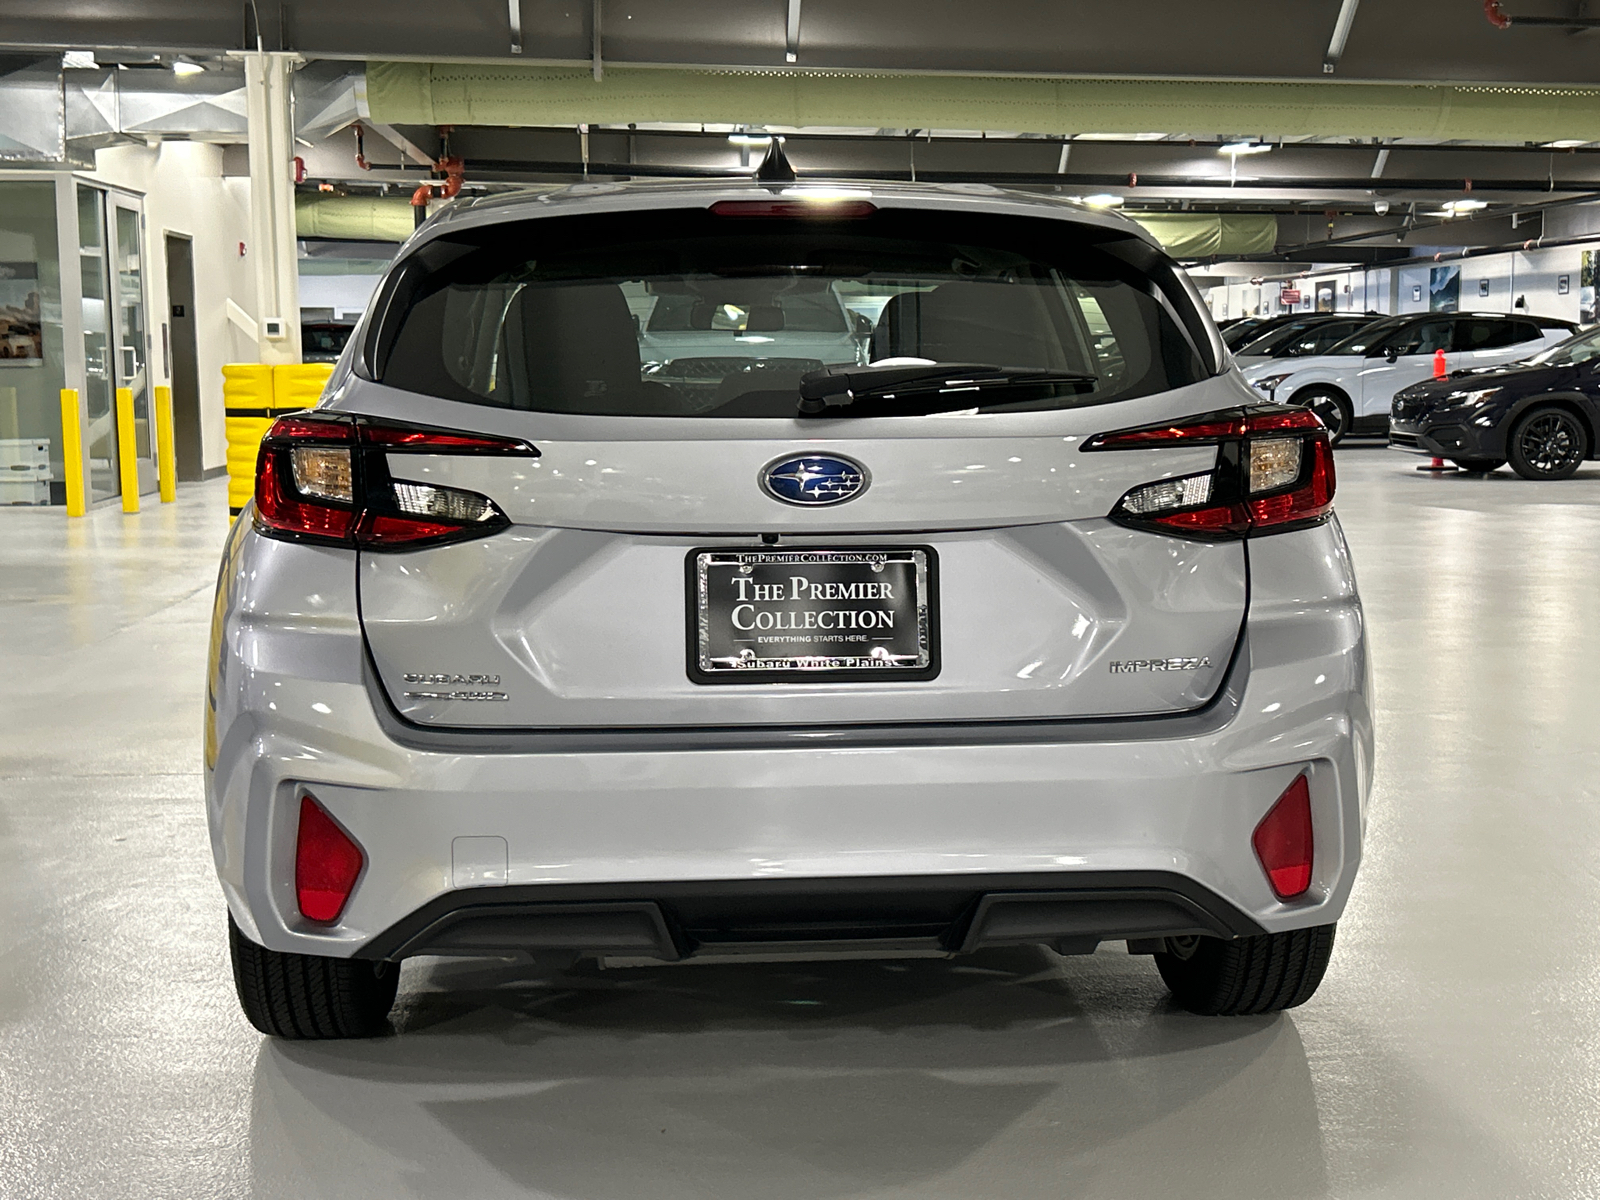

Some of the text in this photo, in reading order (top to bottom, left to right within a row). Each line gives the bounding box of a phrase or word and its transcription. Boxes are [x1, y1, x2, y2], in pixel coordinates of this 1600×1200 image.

[731, 576, 895, 601] THE PREMIER
[731, 604, 895, 630] COLLECTION
[757, 635, 811, 643] EVERYTHING
[738, 660, 791, 669] Subaru
[796, 659, 840, 669] White
[1109, 656, 1213, 673] IMPREZA
[403, 672, 500, 685] SUBARU
